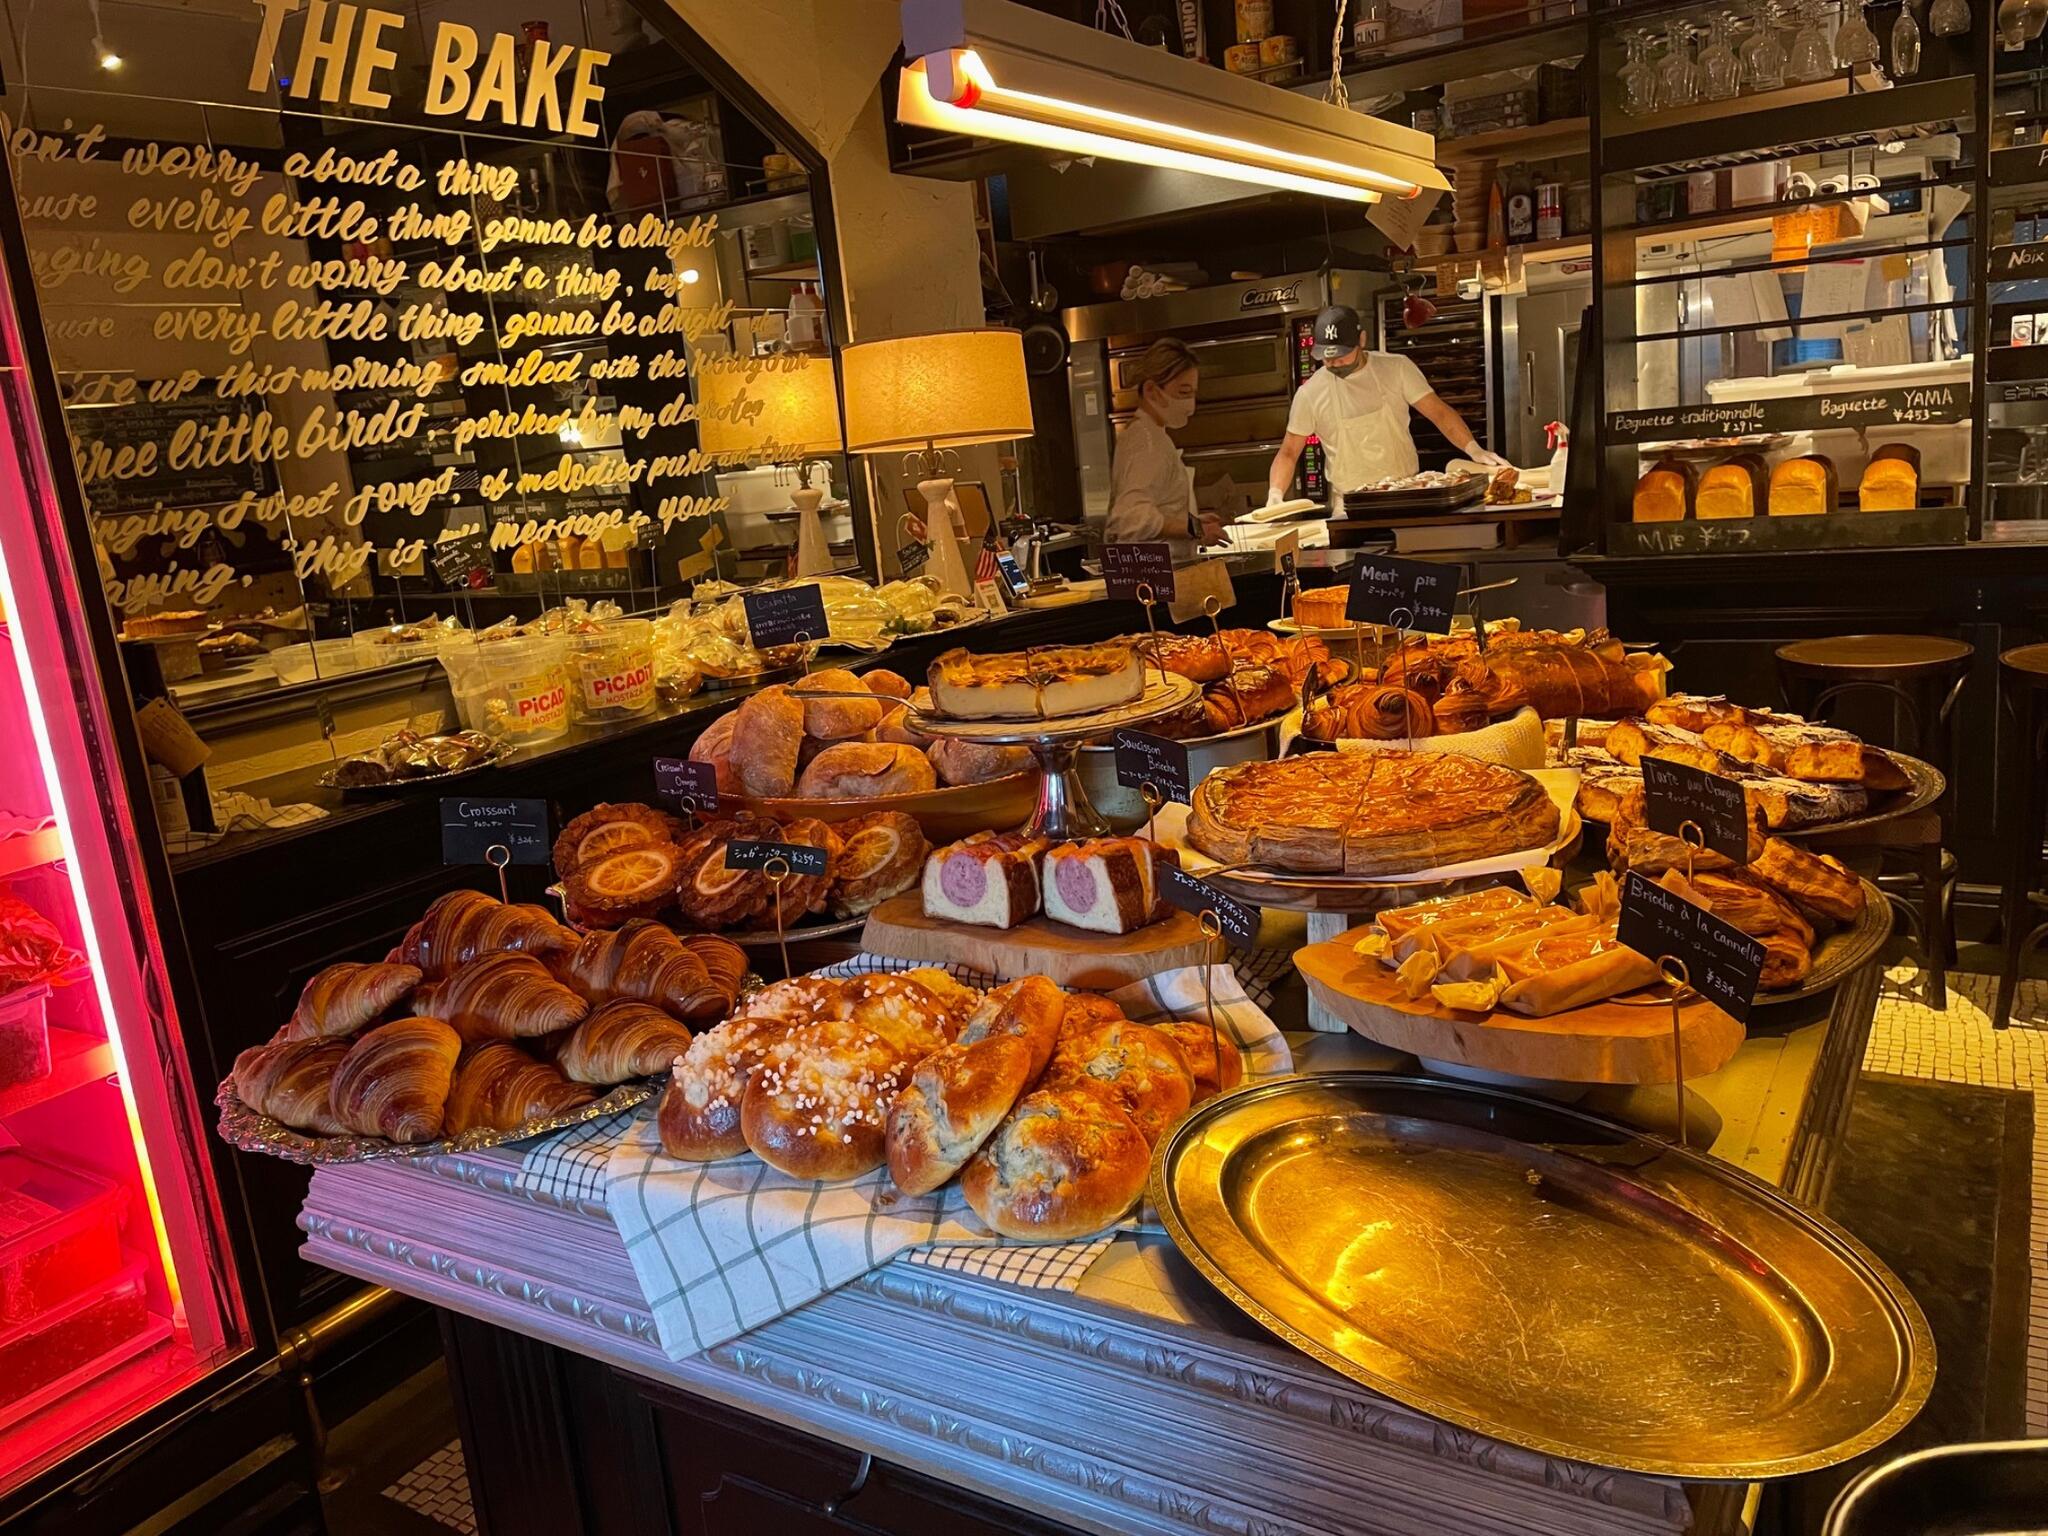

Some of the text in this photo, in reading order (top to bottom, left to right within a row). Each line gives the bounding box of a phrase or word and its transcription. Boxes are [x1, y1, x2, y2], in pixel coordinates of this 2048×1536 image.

[248, 0, 612, 138] THE BAKE
[122, 143, 263, 196] worry
[284, 146, 398, 187] about
[395, 163, 425, 191] a
[437, 158, 519, 201] thing
[128, 188, 253, 248] every
[262, 193, 378, 245] little
[388, 202, 472, 247] thing
[481, 213, 575, 253] gonna
[576, 213, 612, 249] be
[618, 212, 718, 260] alright
[163, 248, 282, 290] don't
[287, 256, 410, 295] worry
[419, 255, 523, 293] about
[523, 266, 550, 291] a
[1241, 280, 1303, 306] Camel
[154, 305, 265, 355] every
[272, 299, 388, 343] little
[399, 303, 484, 346] thing
[499, 308, 599, 349] gonna
[601, 300, 637, 337] be
[638, 299, 736, 343] alright
[149, 370, 204, 402] up
[216, 360, 301, 399] this
[301, 355, 443, 397] morning
[461, 348, 583, 387] smiled
[589, 354, 638, 381] with
[648, 349, 687, 382] the
[1615, 414, 1674, 435] Baguette
[1820, 387, 1954, 420] Baguette YAMA
[169, 411, 289, 471] little
[452, 402, 572, 455] perched
[579, 396, 614, 441] by
[618, 403, 656, 440] my
[217, 482, 341, 530] sweet
[480, 468, 513, 502] of
[516, 453, 648, 495] melodies
[647, 448, 712, 487] pure
[388, 537, 429, 568] is
[490, 508, 624, 552] message
[1106, 547, 1133, 565] Flan
[1361, 565, 1399, 583] Meat
[459, 802, 518, 818] Croissant
[1630, 877, 1762, 968] Brioche à la cannelle
